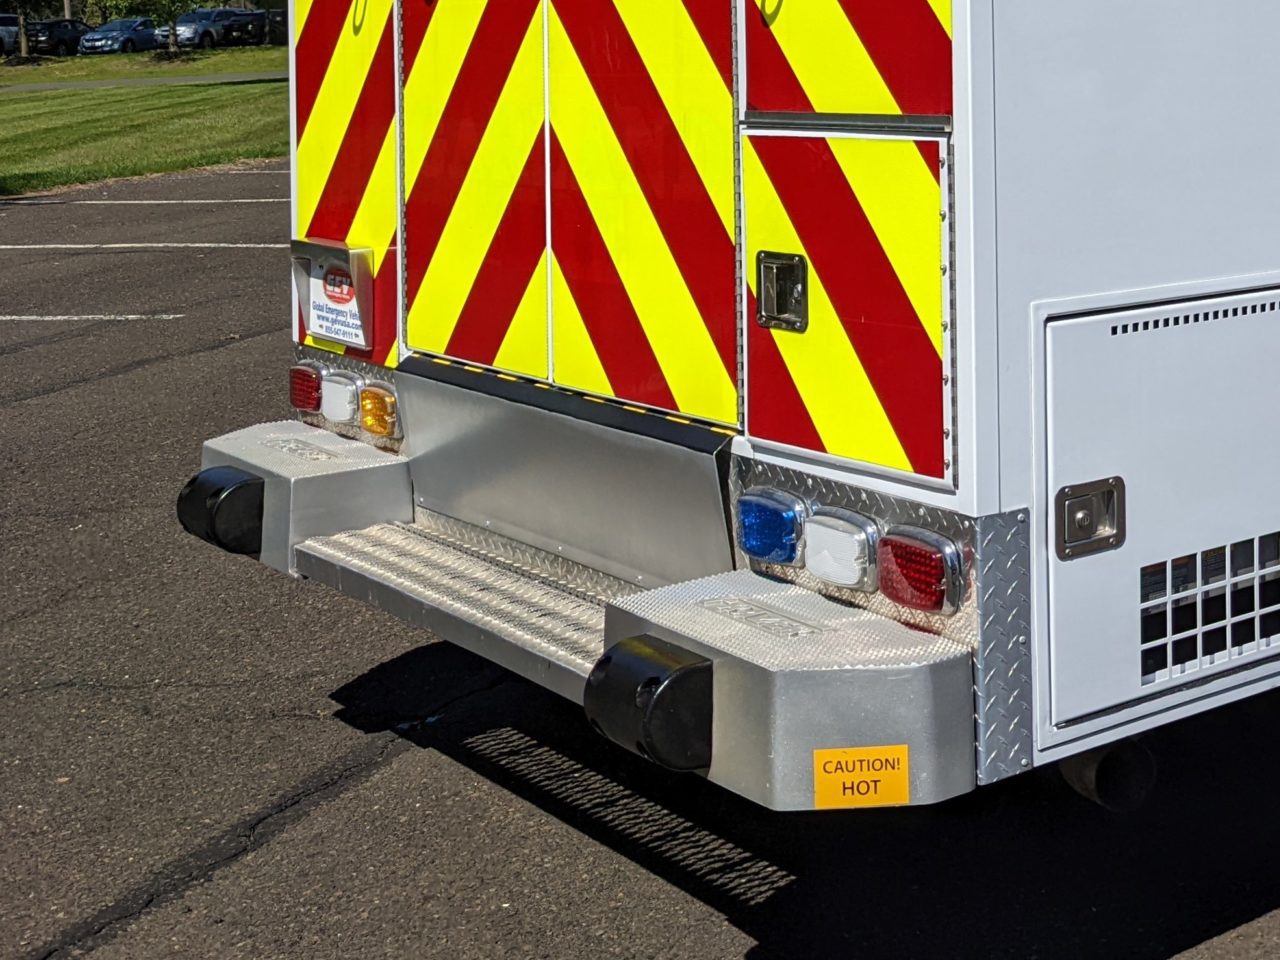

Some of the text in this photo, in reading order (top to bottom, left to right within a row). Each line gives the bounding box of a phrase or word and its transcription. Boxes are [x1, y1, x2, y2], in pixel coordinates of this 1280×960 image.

[325, 304, 348, 320] Emergency
[823, 757, 900, 773] CAUTION!
[842, 780, 881, 796] HOT
